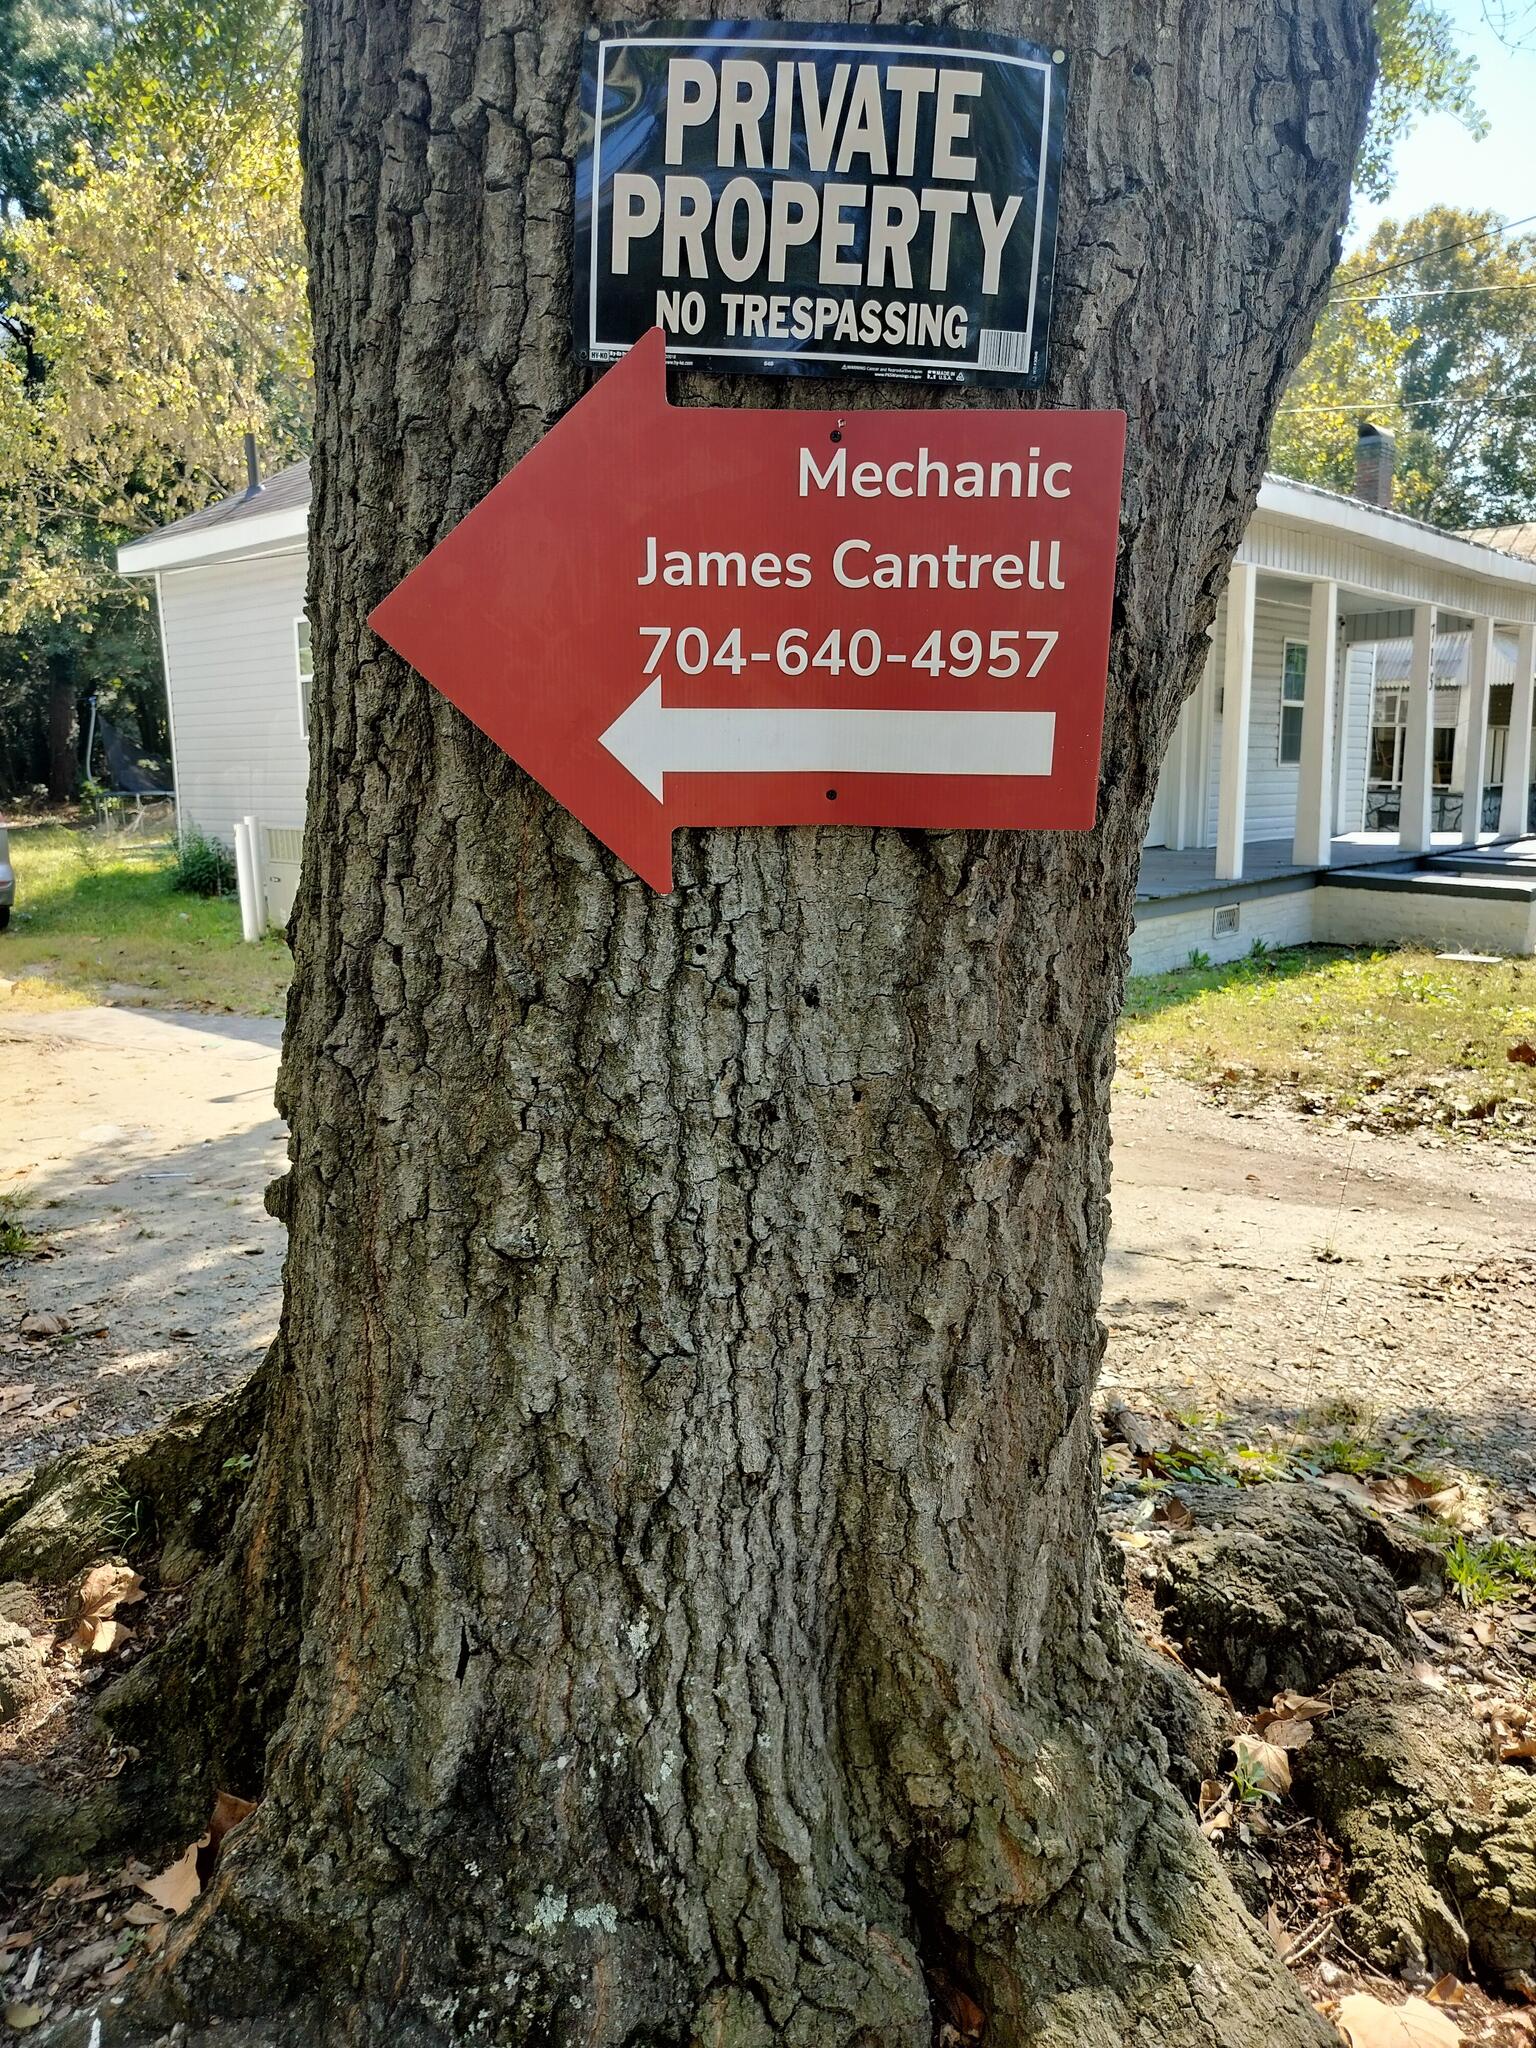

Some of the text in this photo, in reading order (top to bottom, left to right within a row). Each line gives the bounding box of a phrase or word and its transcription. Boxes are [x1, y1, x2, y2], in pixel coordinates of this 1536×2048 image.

[665, 58, 983, 181] PRIVATE
[611, 172, 1024, 296] PROPERTY
[655, 290, 969, 349] NO TRESPASSING
[799, 446, 1073, 499] Mechanic
[637, 536, 1066, 590] James Cantrell
[639, 626, 1059, 678] 704-640-4957
